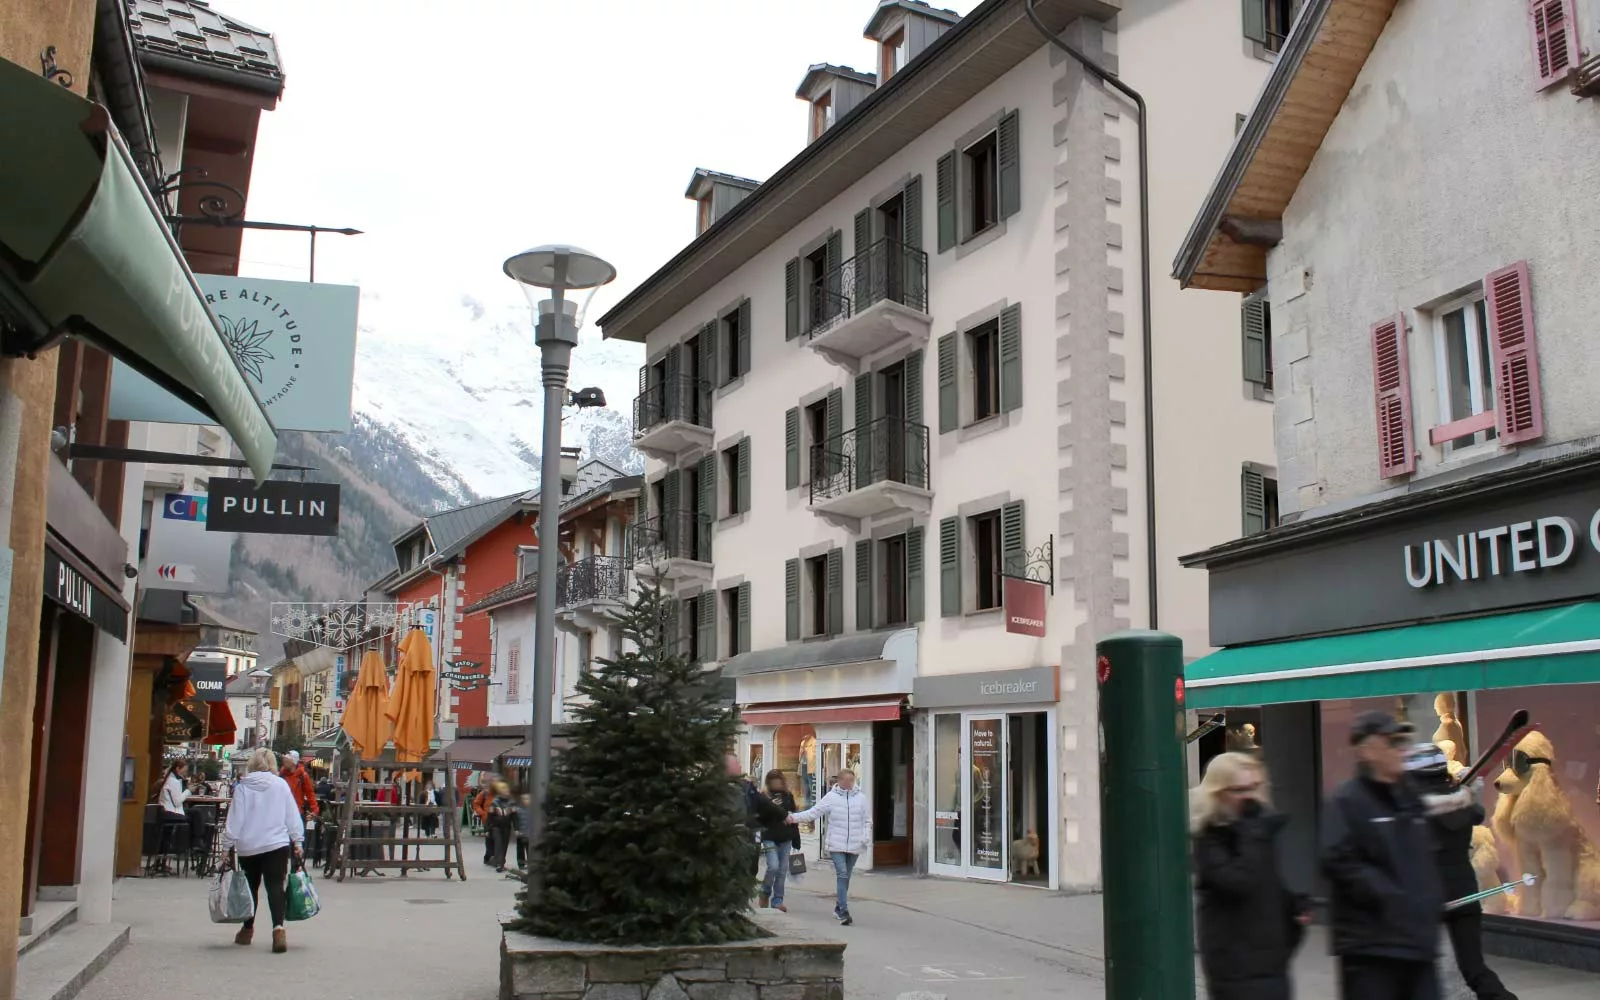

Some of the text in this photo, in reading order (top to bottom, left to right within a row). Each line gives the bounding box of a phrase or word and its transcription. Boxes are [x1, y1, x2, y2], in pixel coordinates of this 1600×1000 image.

[206, 289, 302, 355] RE ALTITUDE
[262, 375, 297, 408] NTAGNE
[223, 496, 325, 517] PULLIN
[1404, 516, 1575, 588] UNITED
[58, 561, 92, 618] PULLIN
[1011, 616, 1044, 628] ICEBREAKER
[196, 680, 223, 690] COLMAR
[980, 680, 1038, 695] icebreaker
[312, 685, 323, 730] HOTEL
